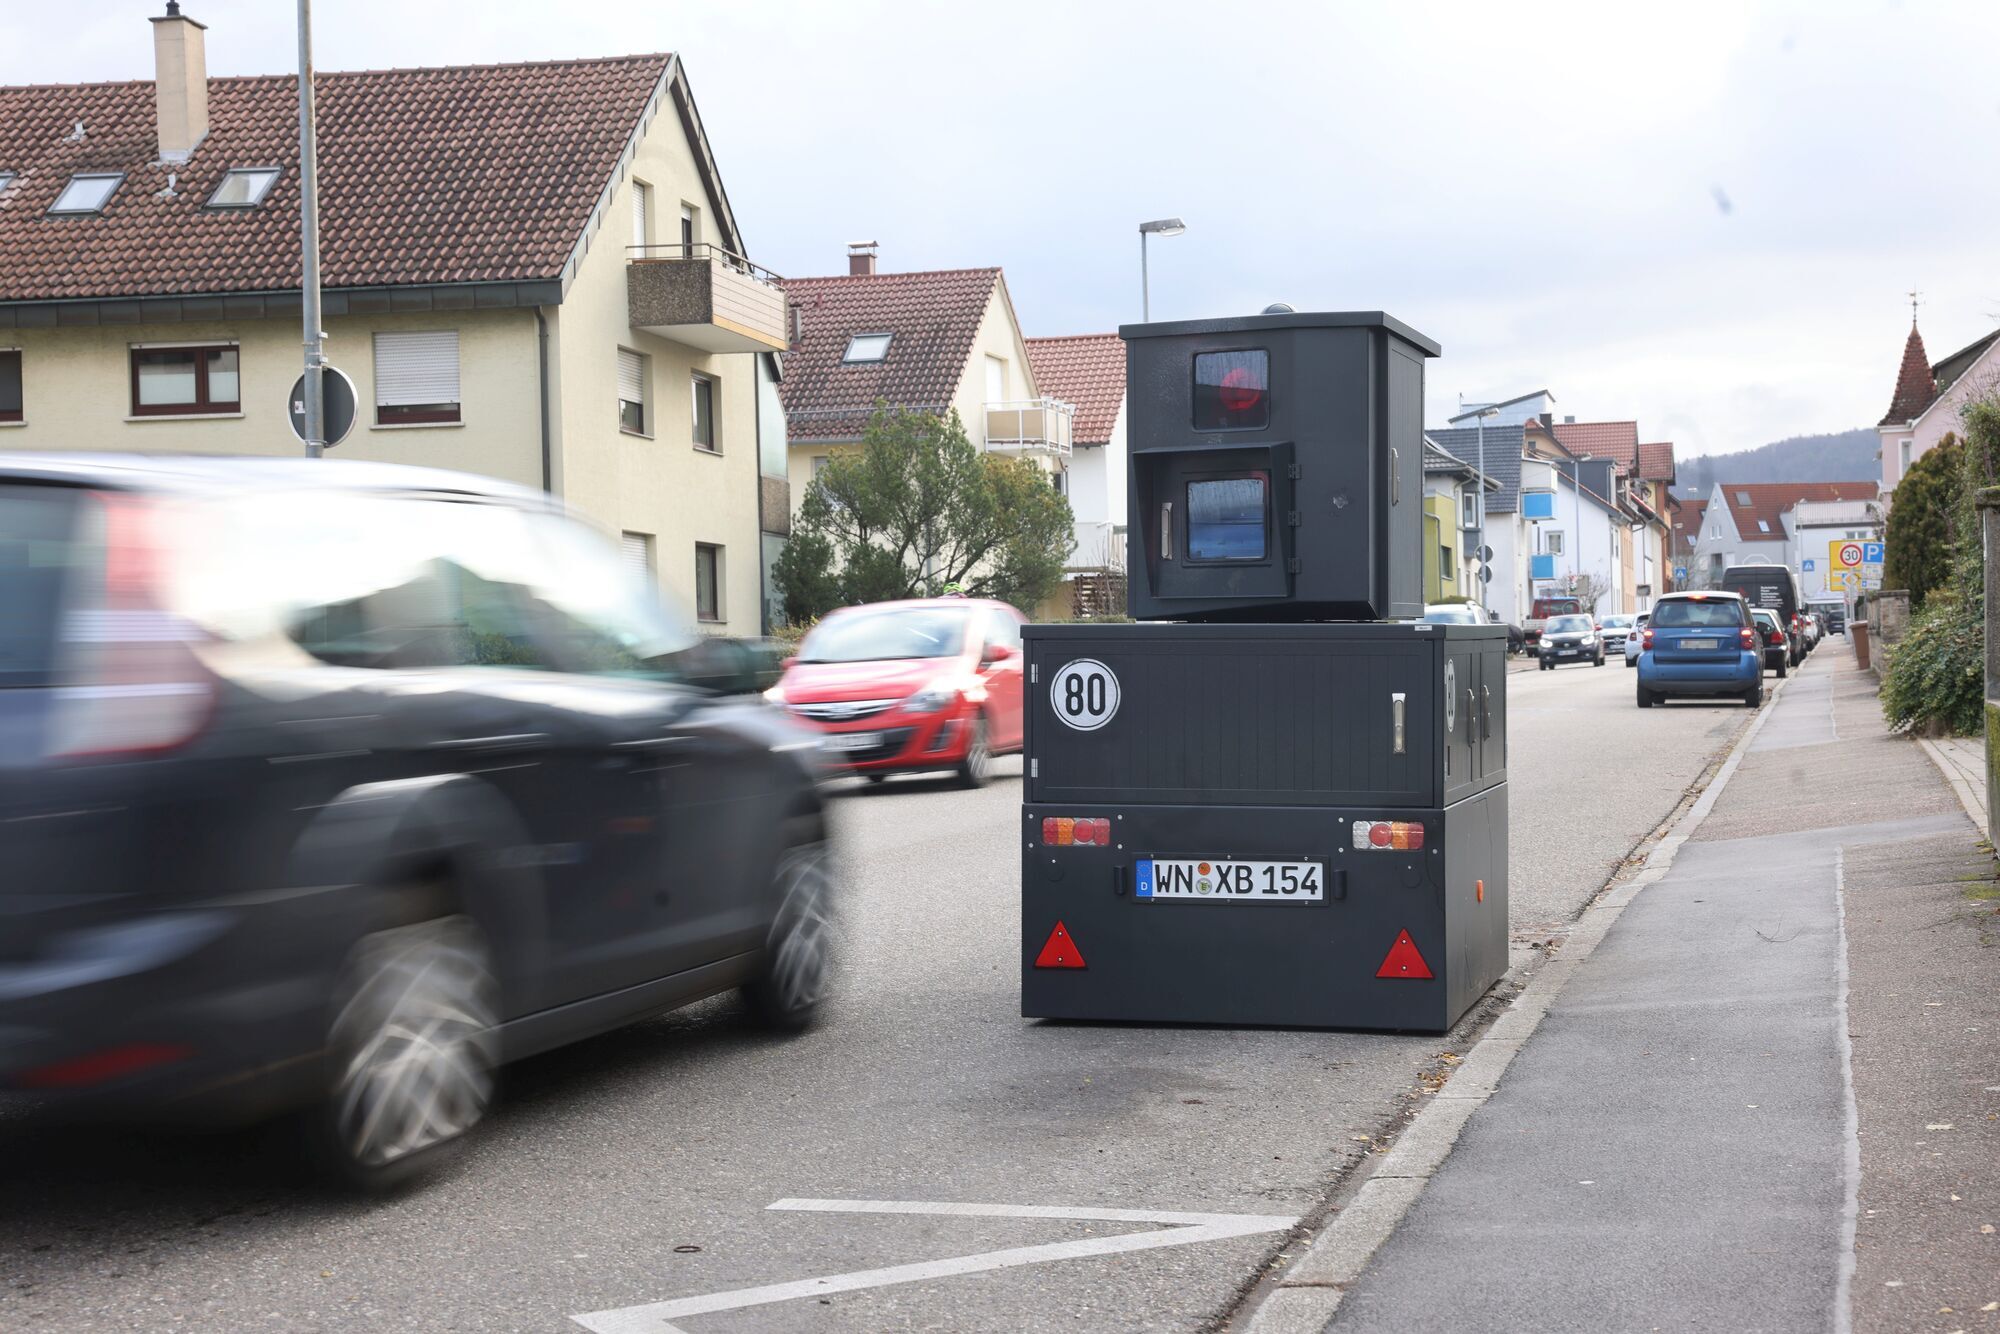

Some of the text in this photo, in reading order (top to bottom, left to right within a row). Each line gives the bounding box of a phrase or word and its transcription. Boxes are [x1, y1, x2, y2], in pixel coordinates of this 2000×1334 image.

[1844, 550, 1858, 561] 30
[1867, 545, 1879, 560] P
[1066, 673, 1105, 716] 80
[1140, 864, 1318, 895] D WN XB 154
